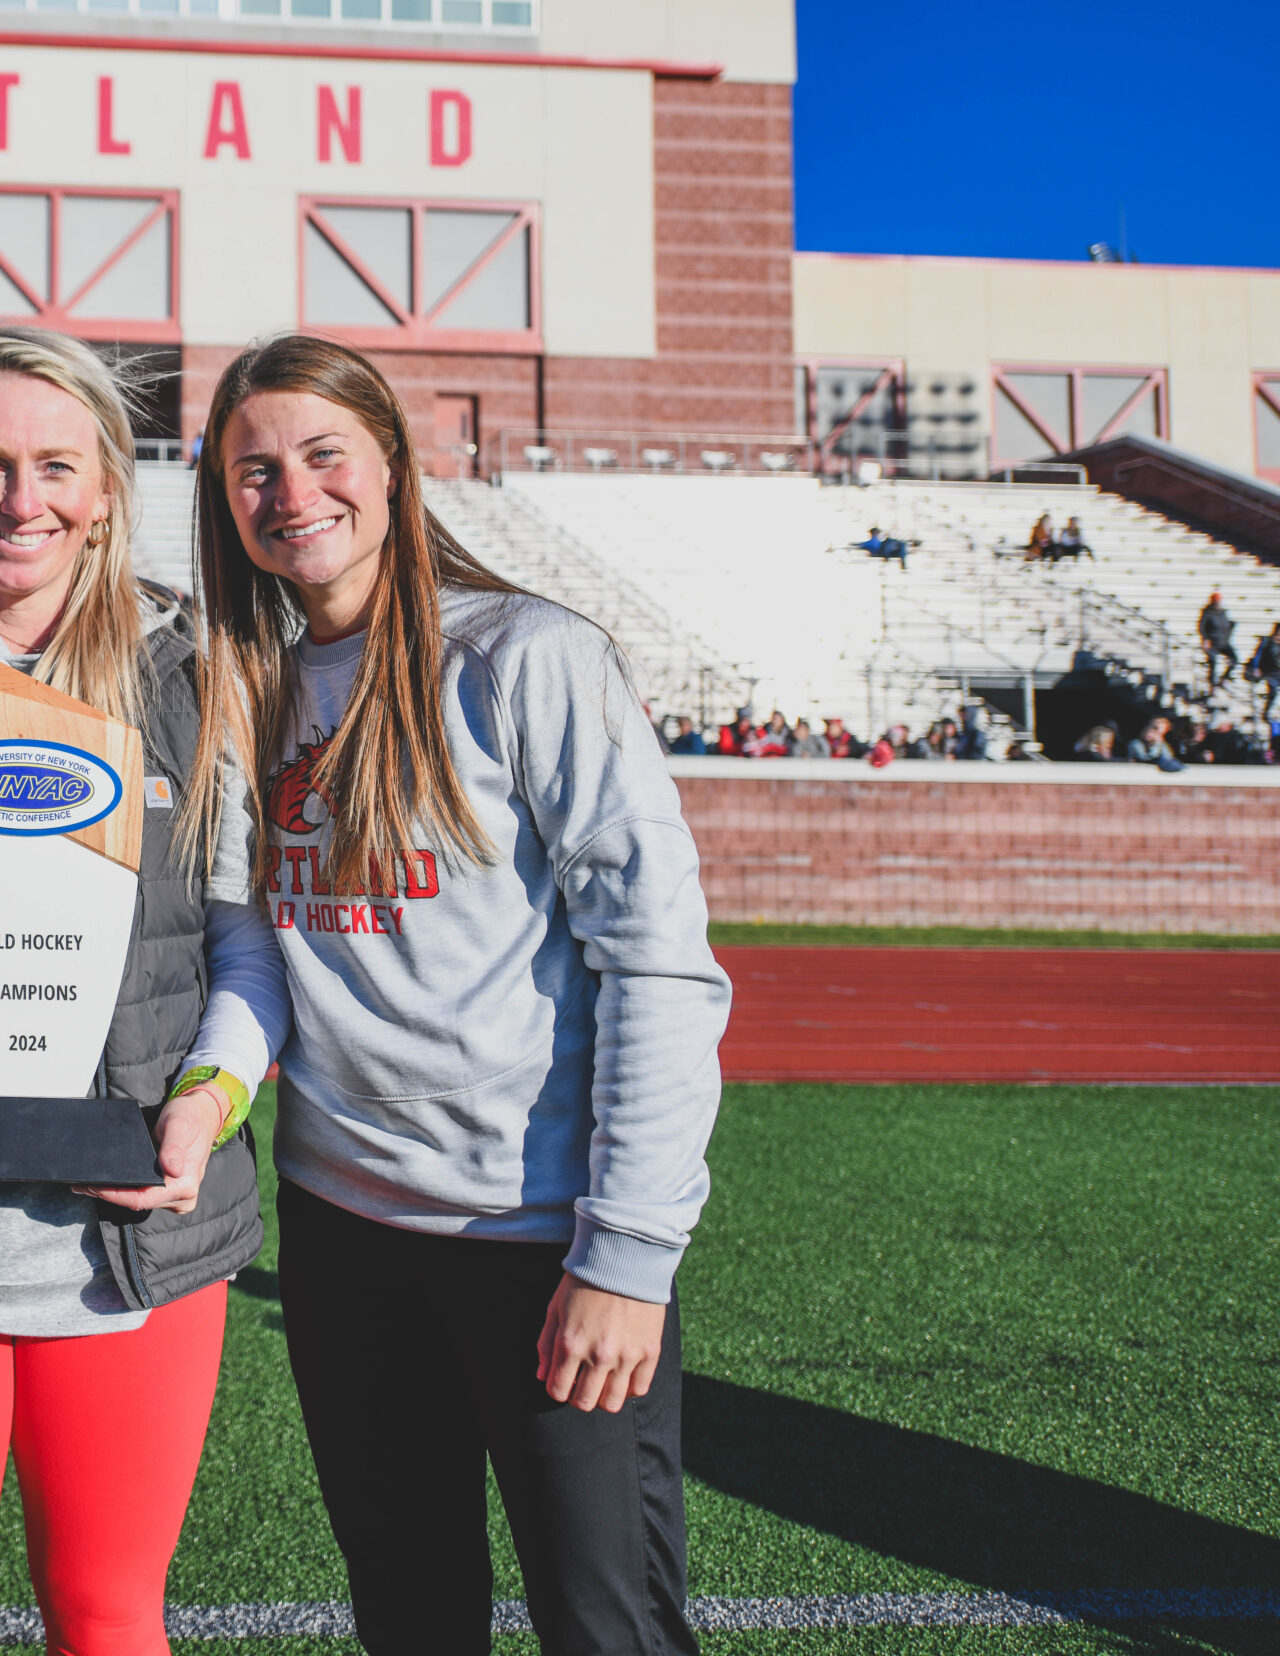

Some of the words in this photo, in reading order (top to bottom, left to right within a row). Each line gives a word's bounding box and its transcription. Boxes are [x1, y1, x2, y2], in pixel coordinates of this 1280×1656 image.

[35, 753, 47, 762] OF
[47, 755, 67, 766] NEW
[68, 761, 91, 775] YORK
[16, 811, 71, 822] CONFERENCE
[306, 903, 404, 935] HOCKEY
[22, 934, 83, 950] HOCKEY
[9, 1035, 47, 1051] 2024
